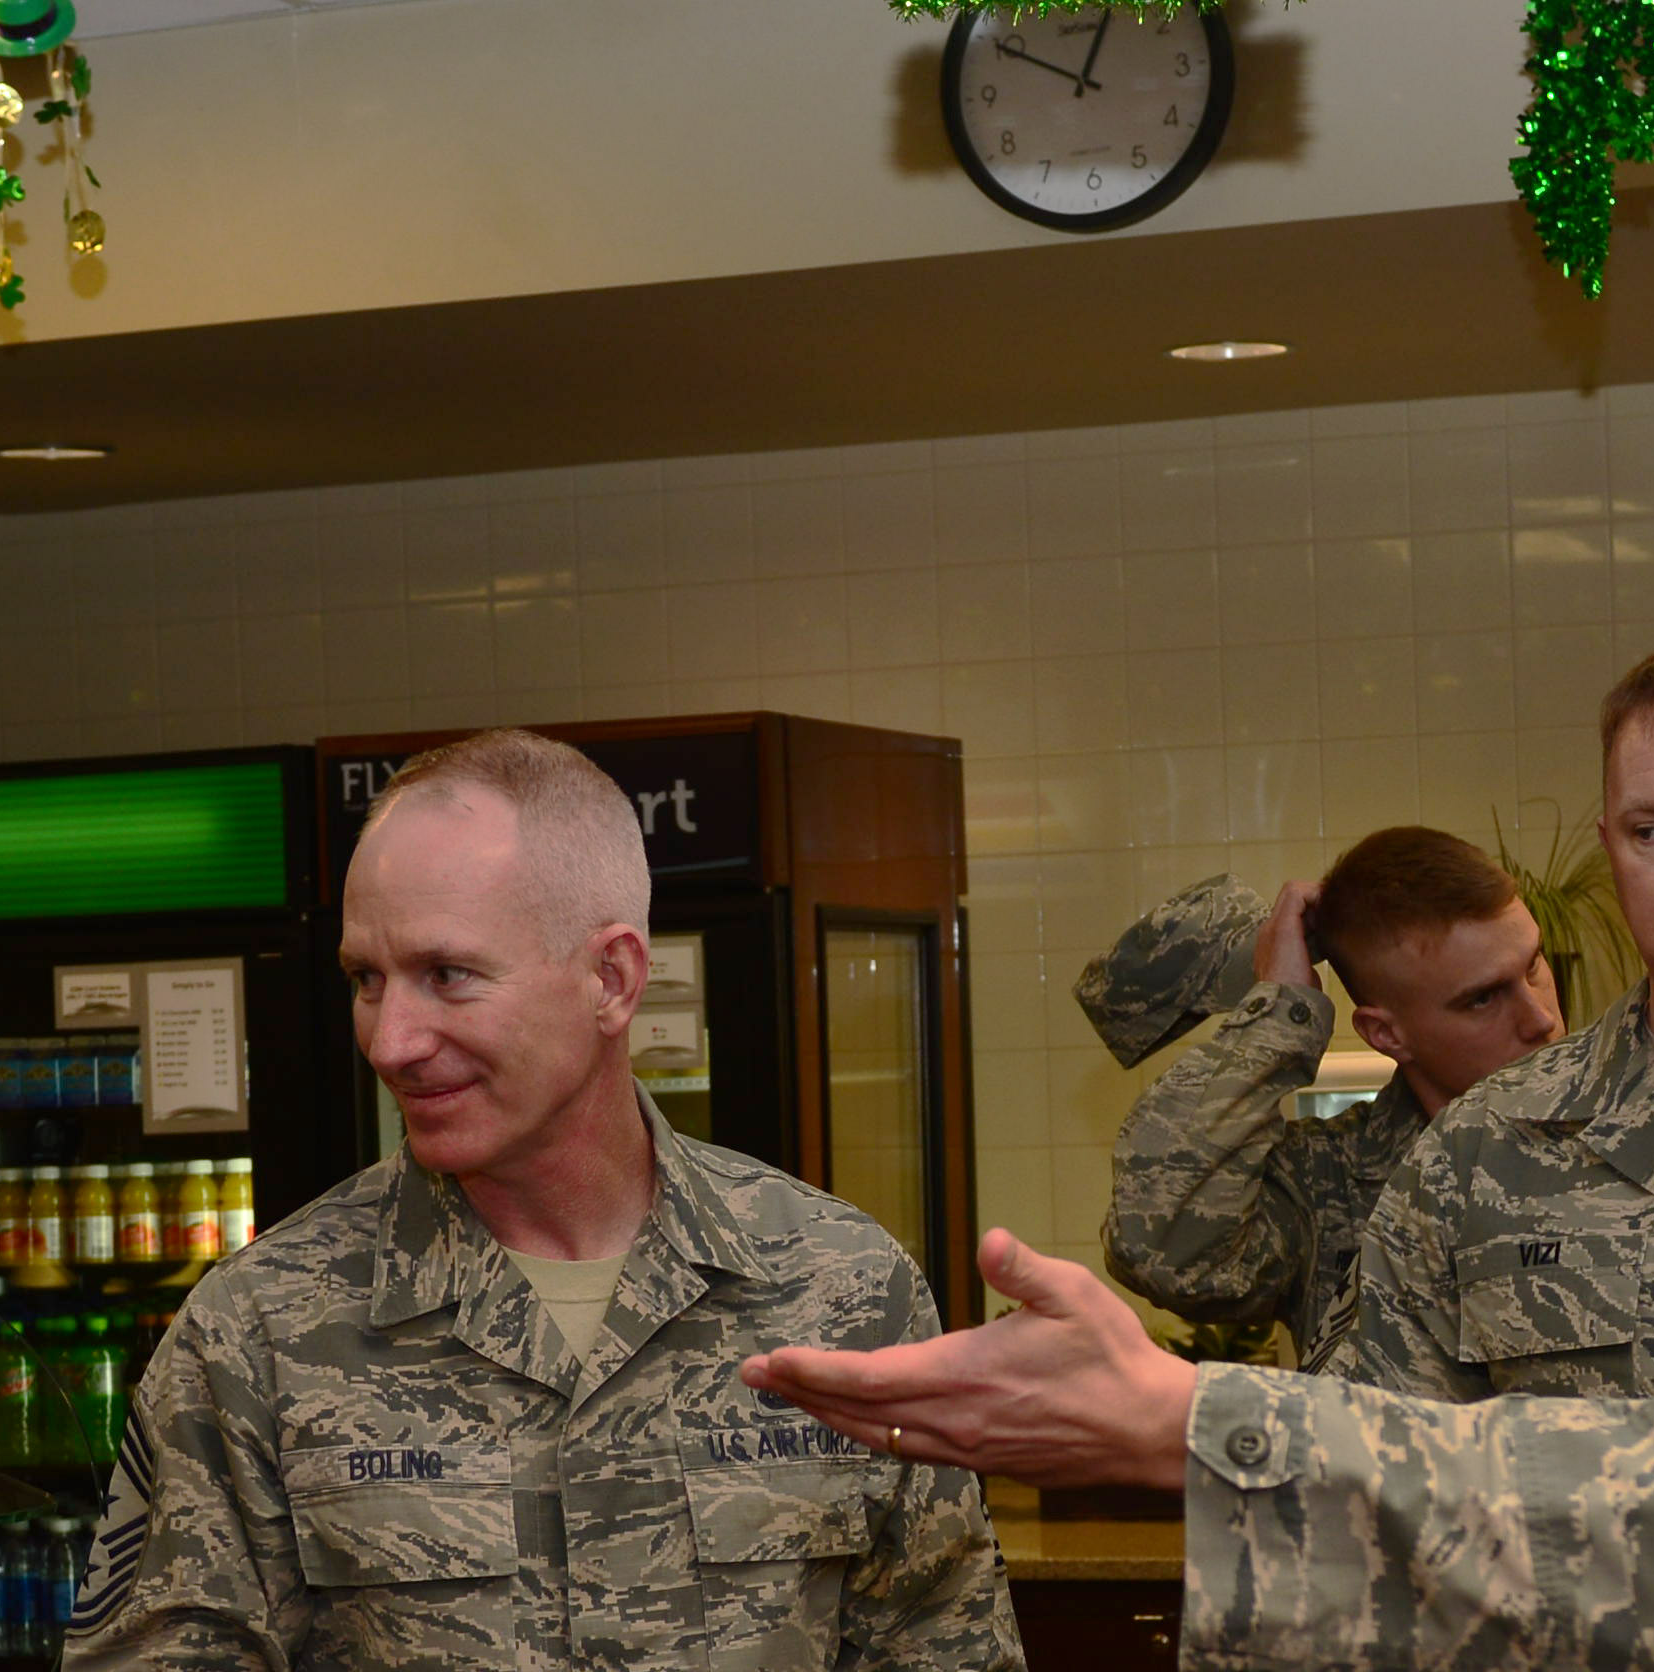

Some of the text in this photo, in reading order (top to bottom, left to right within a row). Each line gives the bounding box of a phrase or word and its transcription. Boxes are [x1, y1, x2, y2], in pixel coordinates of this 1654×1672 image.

[993, 34, 1026, 61] 10
[1174, 53, 1191, 77] 3
[981, 84, 997, 108] 9
[1163, 105, 1178, 129] 4
[1001, 130, 1016, 155] 8
[1131, 145, 1147, 169] 5
[1038, 160, 1052, 184] 7
[1086, 168, 1102, 191] 6
[638, 778, 697, 836] rt
[1519, 1241, 1561, 1267] VIZI
[707, 1431, 752, 1464] U.S.
[757, 1427, 800, 1460] AIR
[348, 1450, 444, 1481] BOLING
